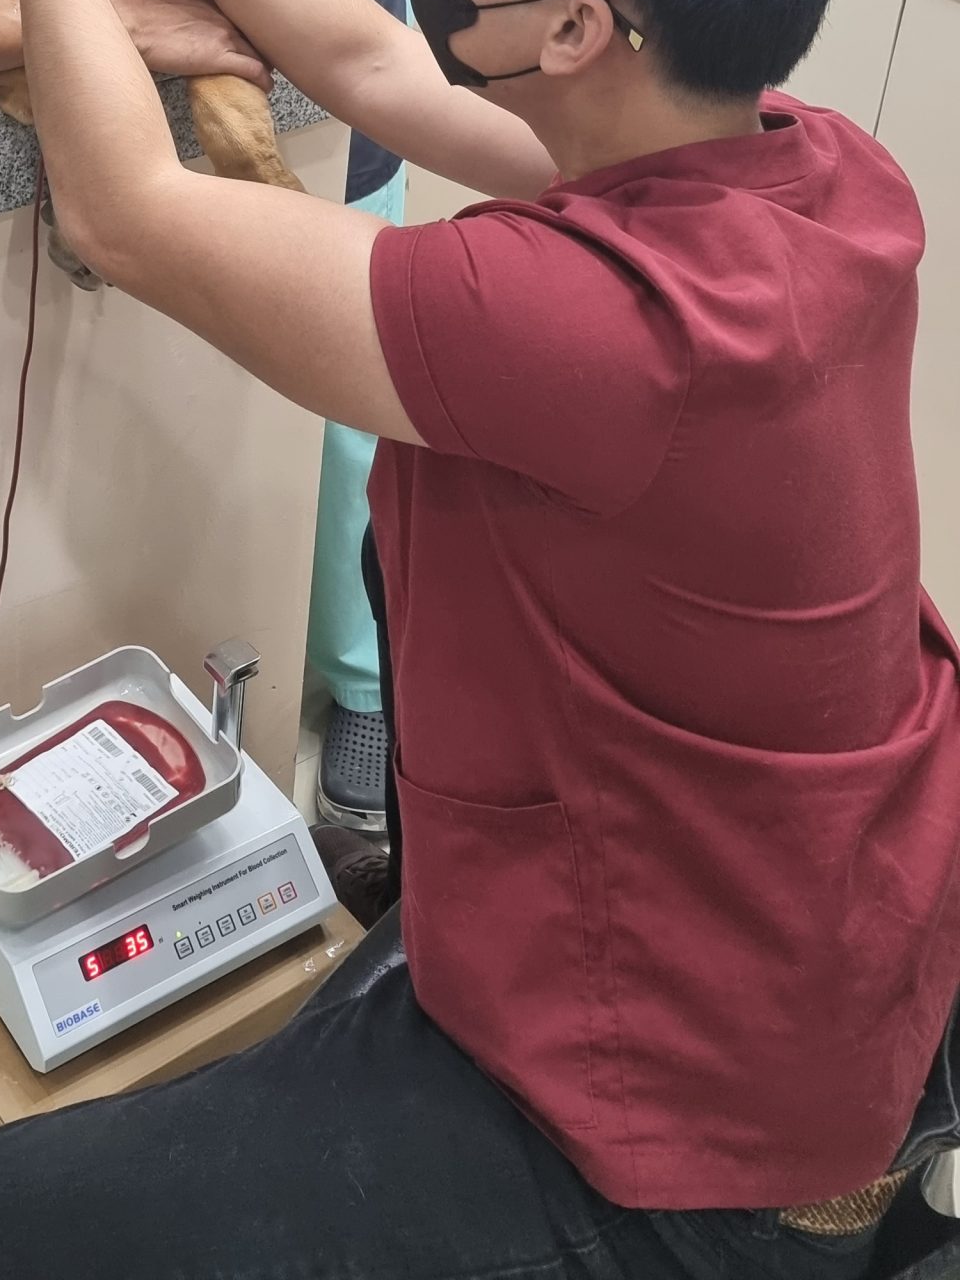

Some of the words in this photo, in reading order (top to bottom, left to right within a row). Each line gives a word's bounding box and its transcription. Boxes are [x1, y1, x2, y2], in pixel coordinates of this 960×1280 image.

[171, 898, 189, 912] Smart
[187, 885, 213, 903] Weighing
[211, 872, 240, 890] Instrument
[238, 868, 248, 878] For
[247, 860, 264, 873] Blood
[262, 848, 288, 865] Collection
[86, 956, 99, 977] 5
[125, 930, 149, 958] 35
[55, 1002, 102, 1033] BIOBASE
